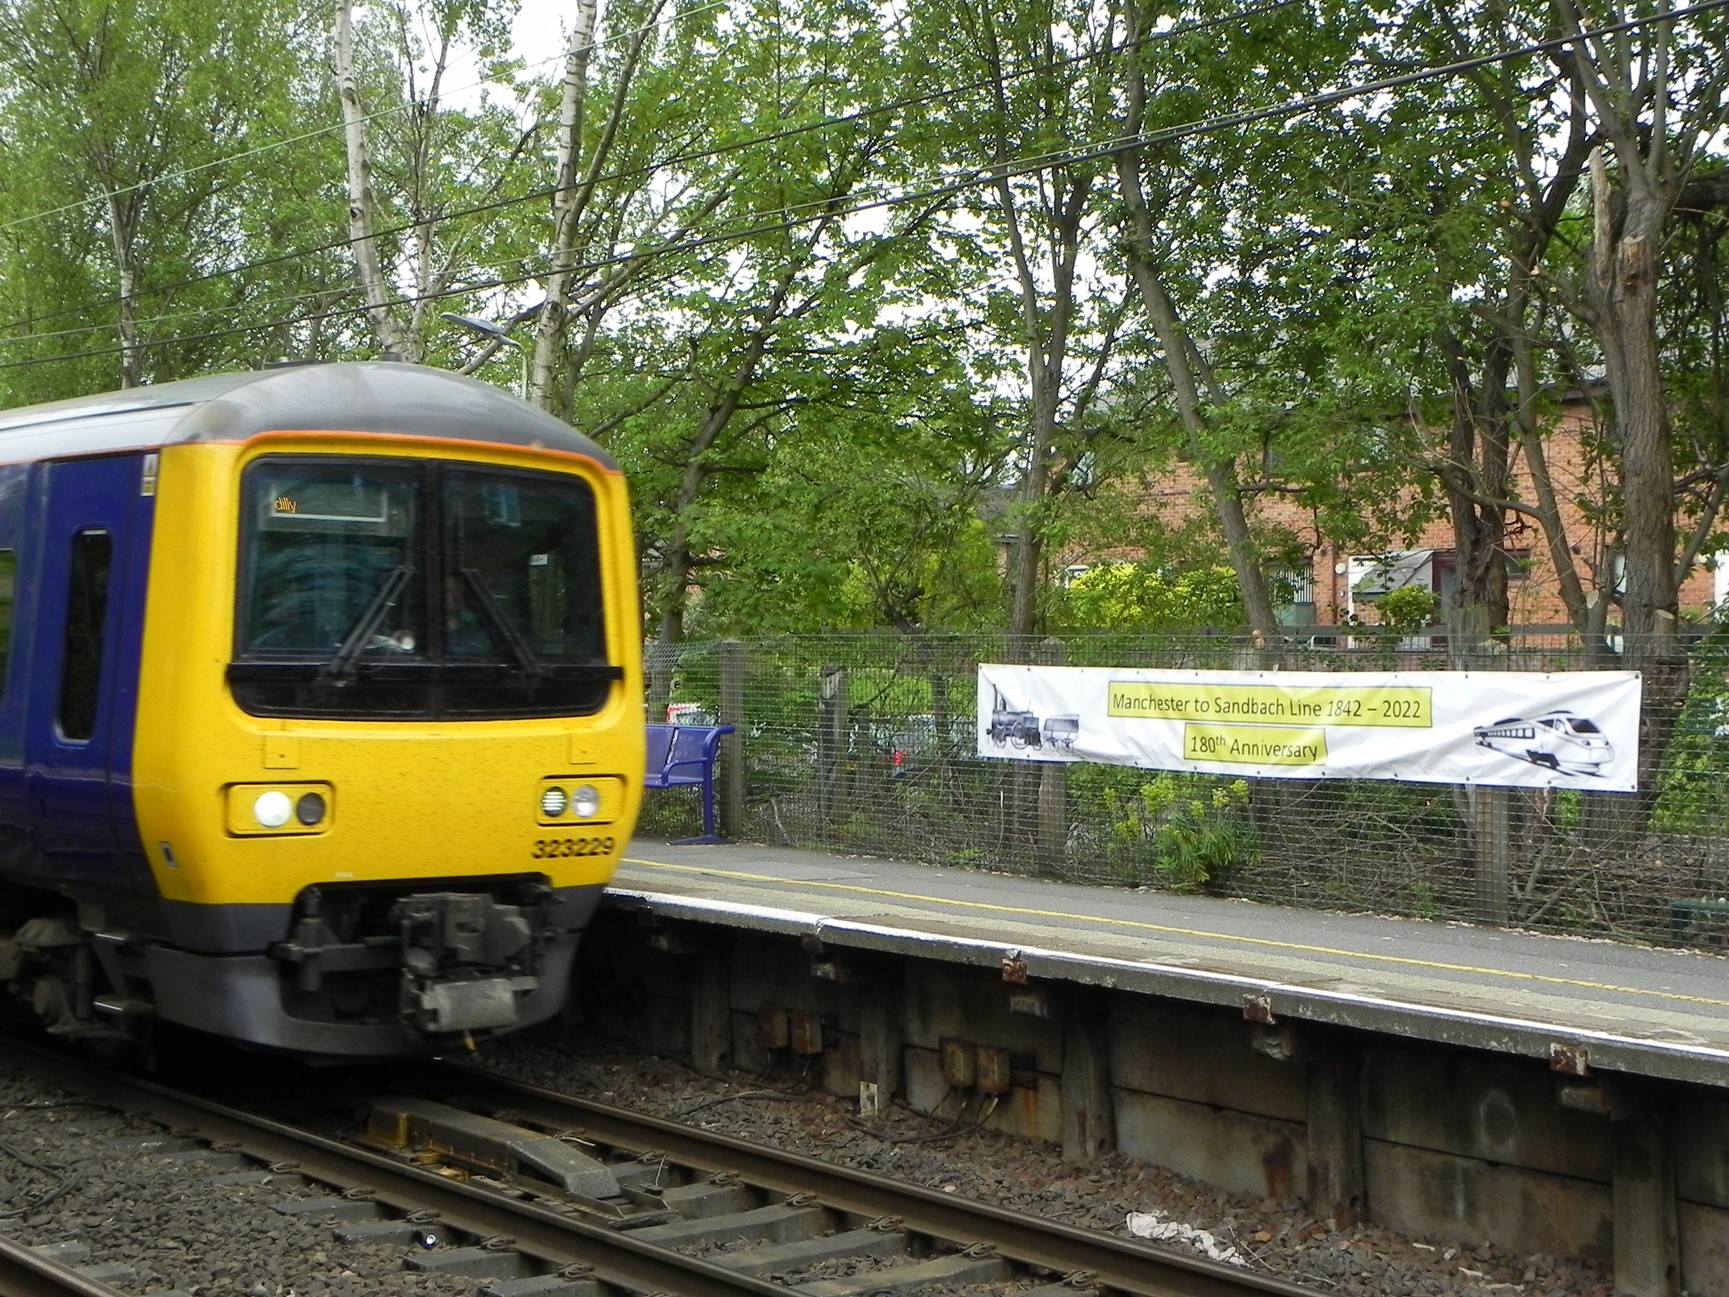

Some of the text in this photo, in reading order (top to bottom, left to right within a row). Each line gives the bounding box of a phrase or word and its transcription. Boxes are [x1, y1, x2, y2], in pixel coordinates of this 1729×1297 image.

[1113, 693, 1190, 713] Manchester
[1194, 697, 1210, 713] to
[1214, 697, 1284, 716] Sandbach
[1290, 699, 1322, 717] Line
[1326, 699, 1362, 717] 1842
[1382, 699, 1421, 718] 2022
[1190, 734, 1318, 762] 180th Anniversary
[531, 836, 615, 859] 323229
